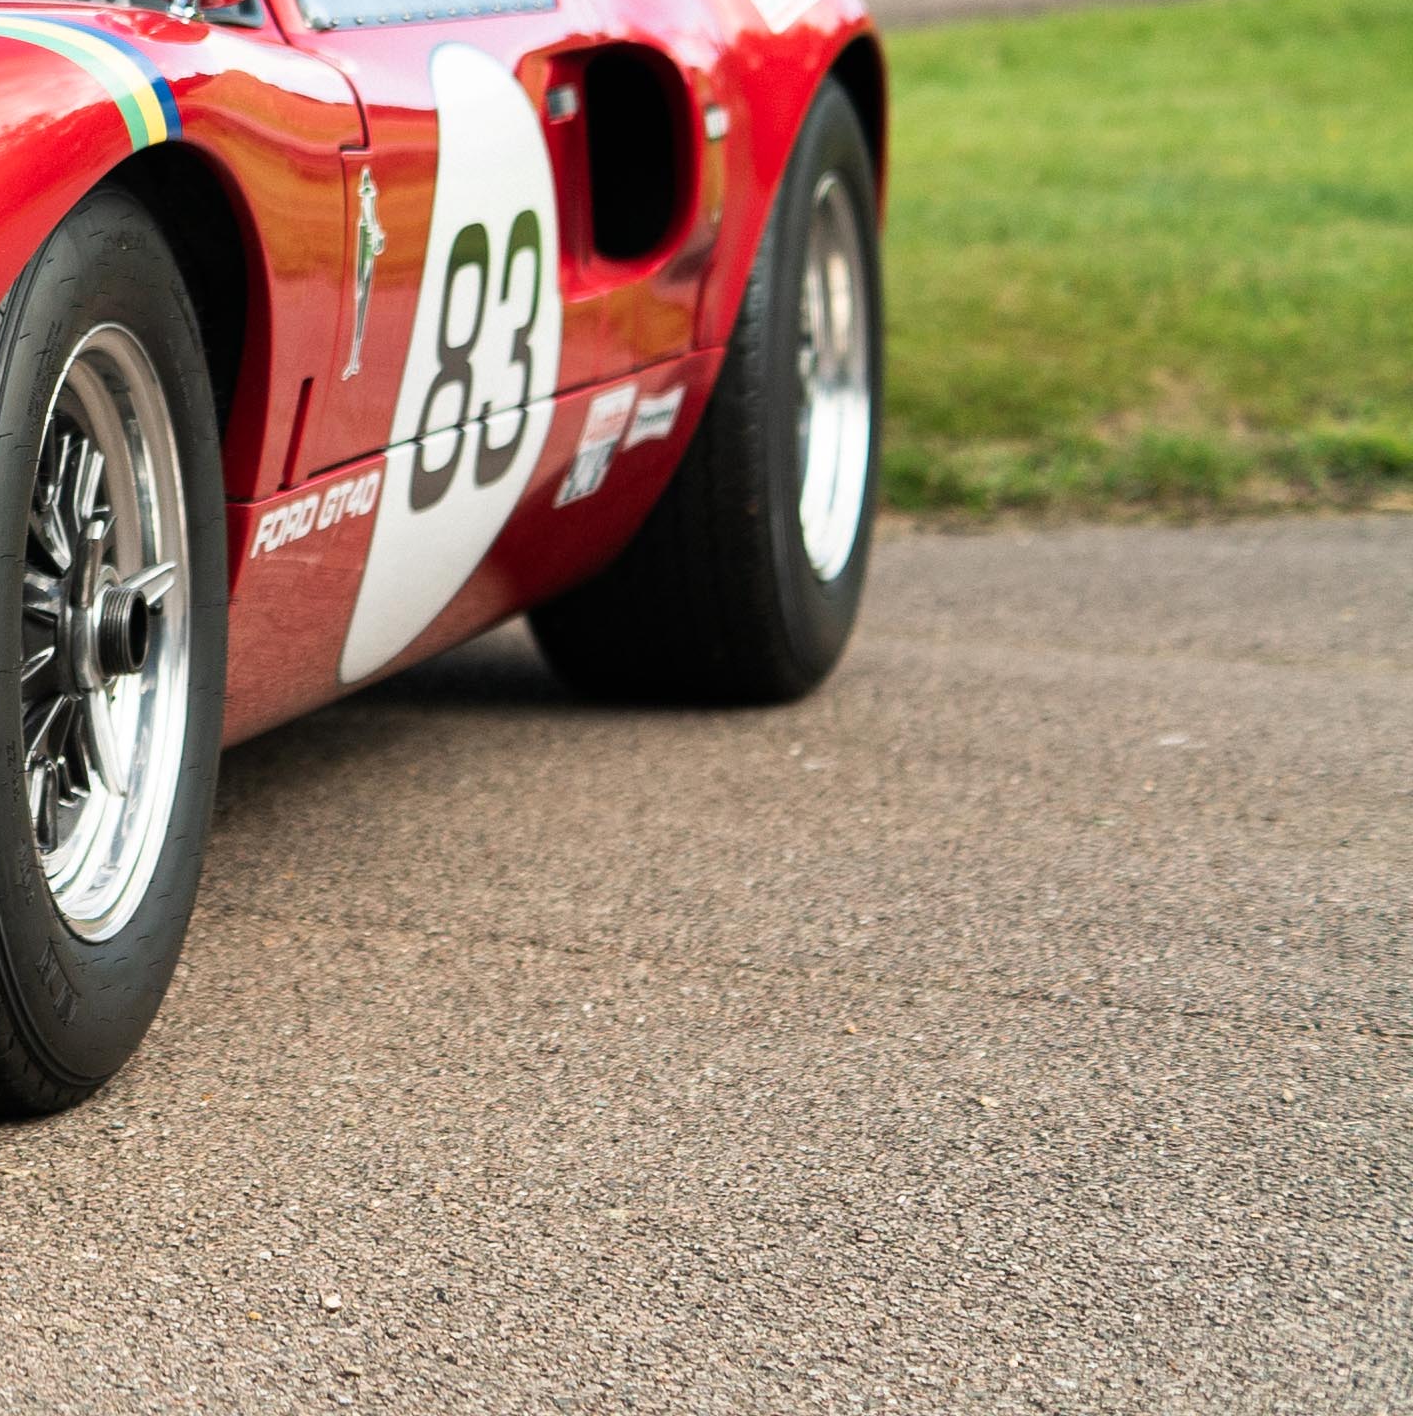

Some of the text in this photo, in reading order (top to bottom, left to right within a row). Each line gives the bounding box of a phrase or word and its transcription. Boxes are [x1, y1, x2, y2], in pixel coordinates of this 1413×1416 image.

[408, 209, 541, 514] 83
[250, 470, 381, 559] FORD GT40
